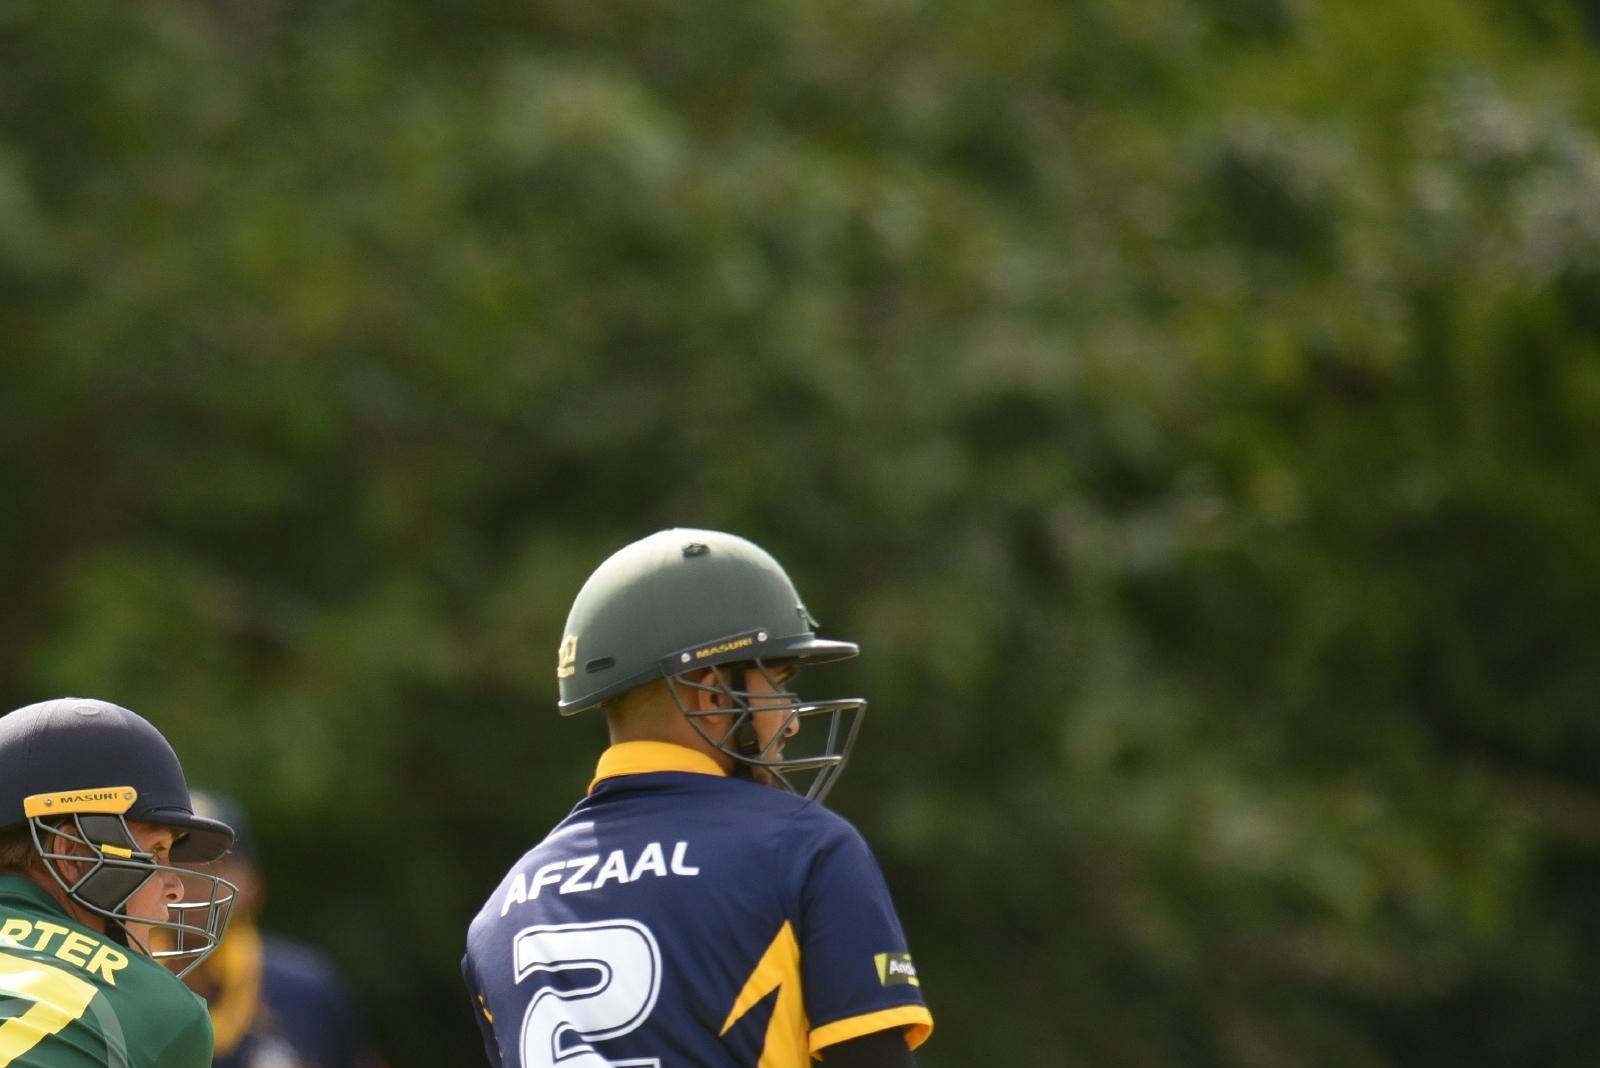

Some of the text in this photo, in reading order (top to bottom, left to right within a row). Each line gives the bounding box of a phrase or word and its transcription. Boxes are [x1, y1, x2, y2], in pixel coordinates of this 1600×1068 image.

[695, 637, 753, 659] MASURI
[59, 792, 118, 804] MASURI
[500, 841, 700, 917] AFZAAL
